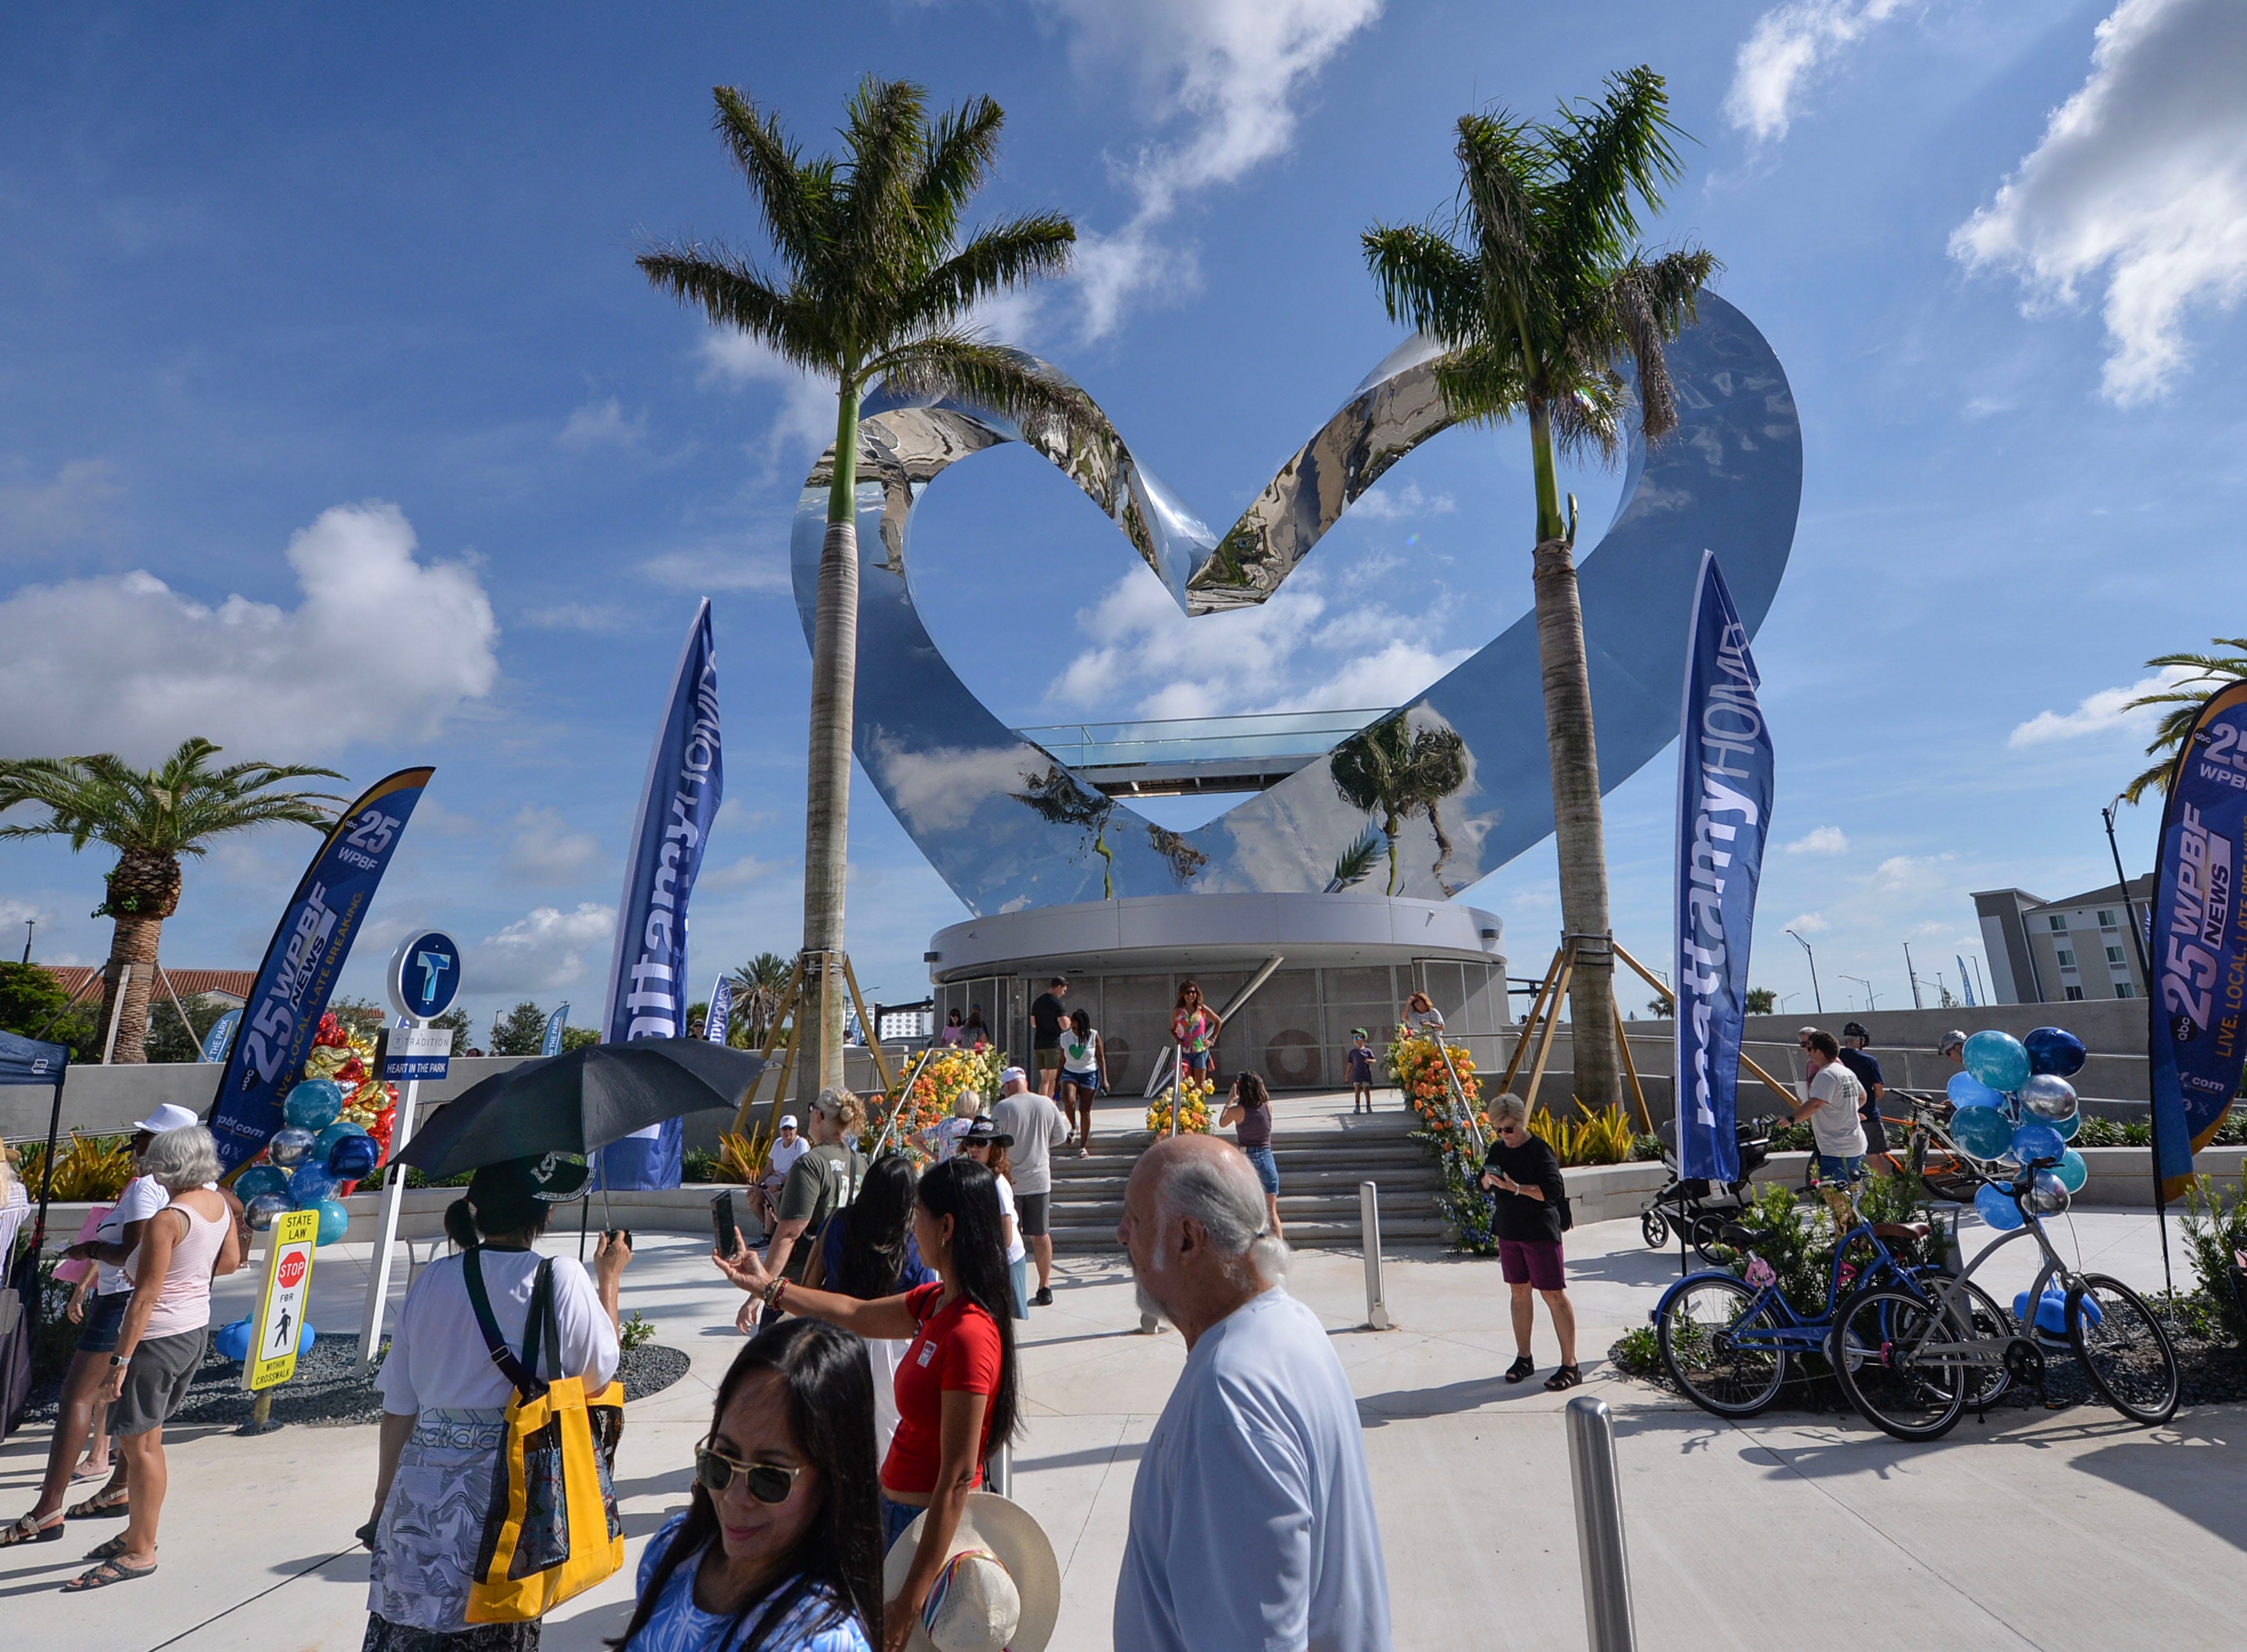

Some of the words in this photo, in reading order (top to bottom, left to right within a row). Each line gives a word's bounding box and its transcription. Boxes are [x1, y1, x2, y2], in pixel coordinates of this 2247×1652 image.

[2195, 733, 2211, 743] abc
[2200, 763, 2247, 790] WPB
[345, 820, 358, 829] abc
[346, 810, 401, 854] 25
[338, 846, 378, 871] WPBF
[2204, 863, 2229, 946] NEWS
[291, 936, 325, 1008] NEWS
[2226, 947, 2247, 1009] LOCAL.
[270, 1069, 293, 1108] LIVE.
[290, 1010, 313, 1065] LOCAL.
[308, 968, 330, 1005] LATE
[325, 890, 365, 965] BREAKING.
[215, 1019, 230, 1039] PARK
[552, 1016, 561, 1034] PARK
[2177, 1017, 2190, 1041] abc
[404, 1037, 449, 1047] TRADITION
[549, 1035, 557, 1048] THE
[2217, 1014, 2238, 1057] LIVE.
[209, 1040, 222, 1055] THE
[387, 1063, 408, 1073] HEART
[408, 1063, 416, 1073] IN
[417, 1063, 429, 1073] THE
[429, 1063, 446, 1073] PARK
[242, 1068, 255, 1091] abc
[286, 1215, 312, 1228] STATE
[288, 1228, 307, 1240] LAW
[280, 1261, 305, 1278] STOP
[280, 1293, 294, 1303] FOR
[266, 1359, 286, 1372] WITHIN
[255, 1368, 290, 1386] CROSSWALK
[410, 1423, 502, 1450] adida
